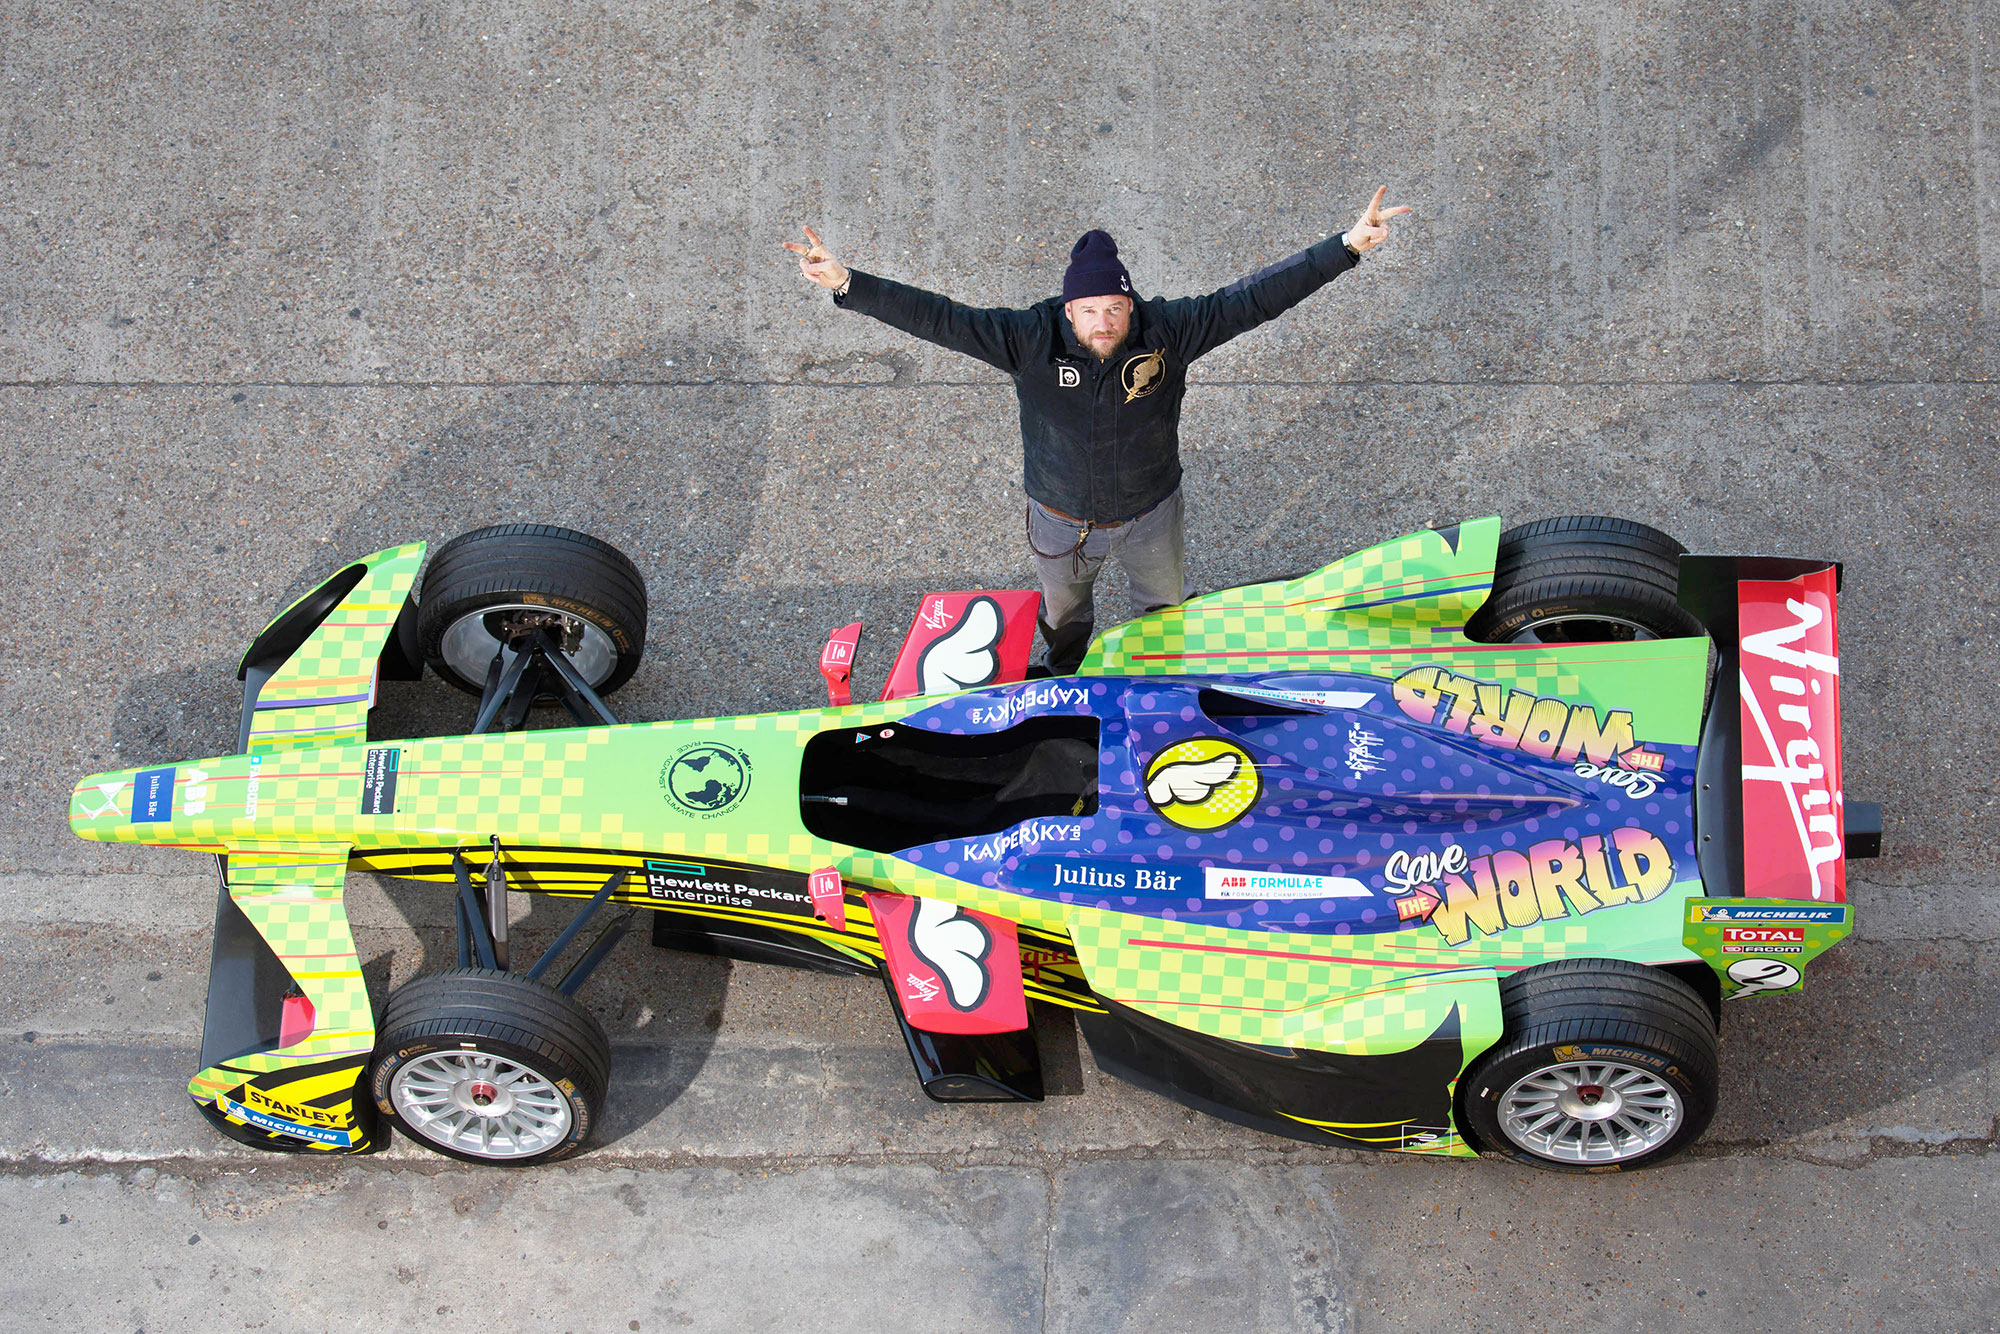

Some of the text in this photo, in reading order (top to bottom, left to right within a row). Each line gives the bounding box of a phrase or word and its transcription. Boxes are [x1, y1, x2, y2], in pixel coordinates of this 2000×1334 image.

[920, 598, 954, 630] Virgin
[982, 684, 1089, 724] KASPERSKY
[1392, 663, 1635, 768] WORLD
[676, 741, 702, 754] RACE
[1630, 752, 1662, 771] THE
[1740, 597, 1842, 899] Virgin
[365, 749, 379, 789] Enterprise
[372, 749, 389, 814] Hewlett Packard
[658, 755, 674, 790] AGAINST
[1573, 762, 1665, 800] Save
[148, 775, 161, 818] Julius Bär
[183, 768, 209, 817] ABB
[663, 793, 740, 820] CLIMATE CHANGE
[963, 821, 1081, 861] KASPERSKY lab
[648, 874, 731, 893] Hewlett
[1053, 863, 1182, 891] Julius Bär
[1221, 877, 1247, 888] ABB
[1383, 844, 1468, 895] Save
[650, 886, 753, 907] Enterprise
[1431, 826, 1677, 948] WORLD
[1397, 896, 1431, 918] THE
[1734, 911, 1833, 919] MICHELIN
[1725, 928, 1803, 941] TOTAL
[906, 973, 940, 1002] Virgin
[1592, 1047, 1665, 1068] MICHELIN
[374, 1055, 397, 1098] MICHELIN
[250, 1091, 339, 1124] STANLEY
[573, 1096, 589, 1140] MICHELIN
[251, 1115, 338, 1141] MICHELIN
